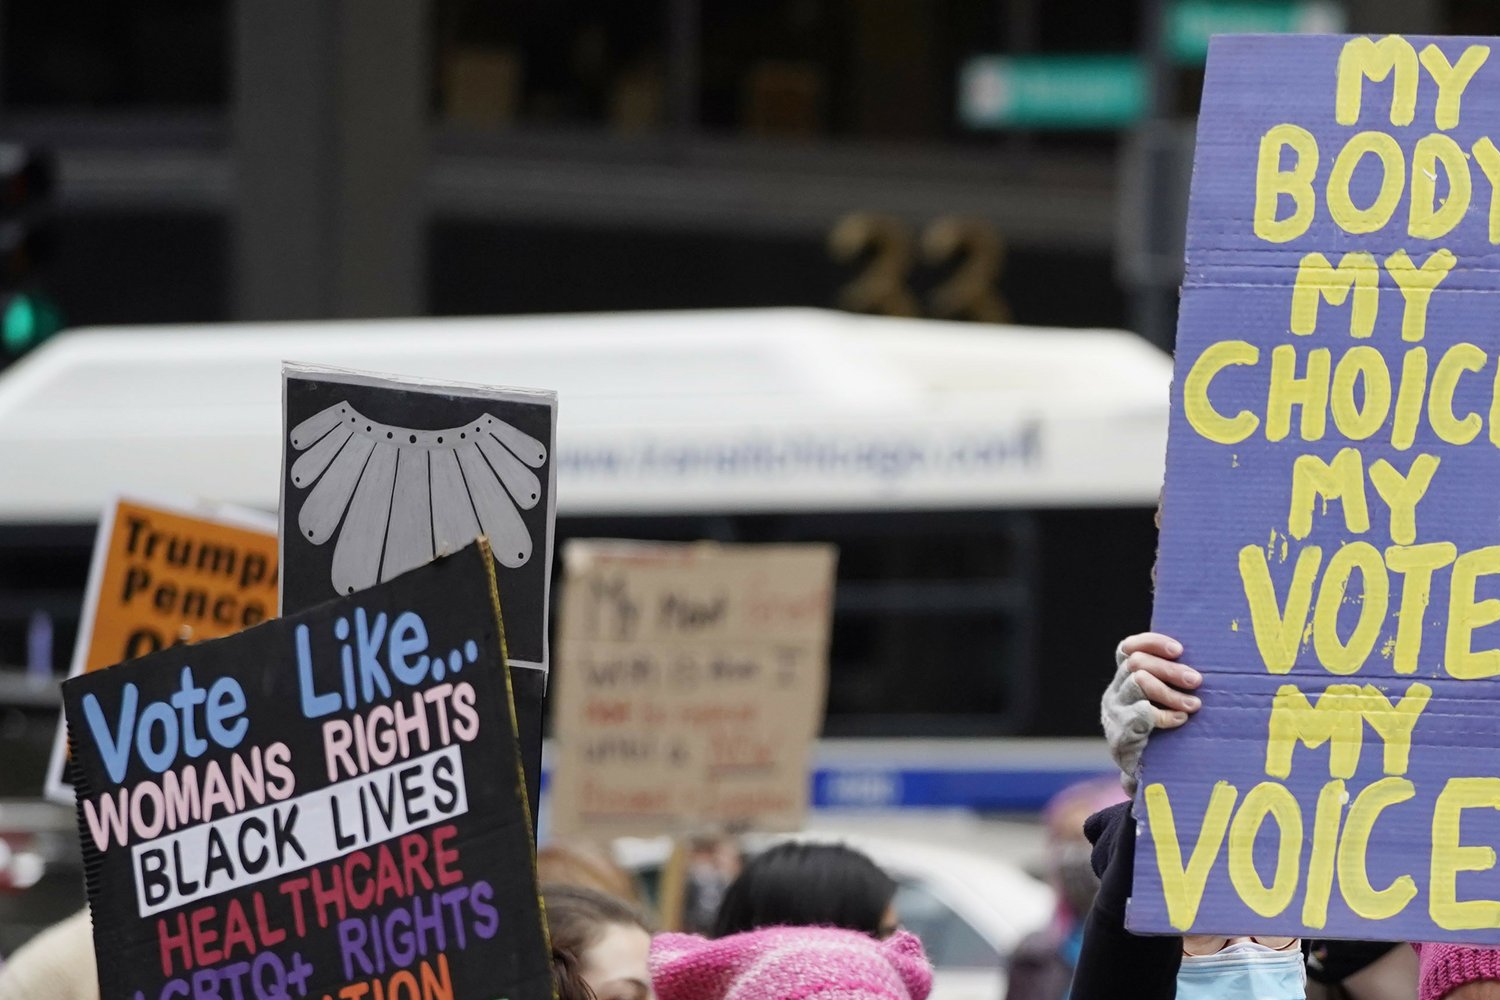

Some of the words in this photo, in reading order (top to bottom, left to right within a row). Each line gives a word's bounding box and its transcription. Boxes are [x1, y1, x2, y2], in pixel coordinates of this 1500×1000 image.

[1335, 34, 1490, 130] MY
[1290, 247, 1457, 343] MY
[1288, 447, 1441, 546] MY
[121, 566, 267, 628] Pence
[83, 666, 250, 784] Vote
[294, 606, 478, 719] Like...
[1265, 681, 1433, 780] MY
[83, 741, 295, 851] WOMANS
[323, 682, 480, 782] RIGHTS
[140, 803, 307, 907] BLACK
[331, 755, 460, 850] LIVES
[157, 825, 463, 977] HEALTHCARE
[338, 880, 500, 981] RIGHTS
